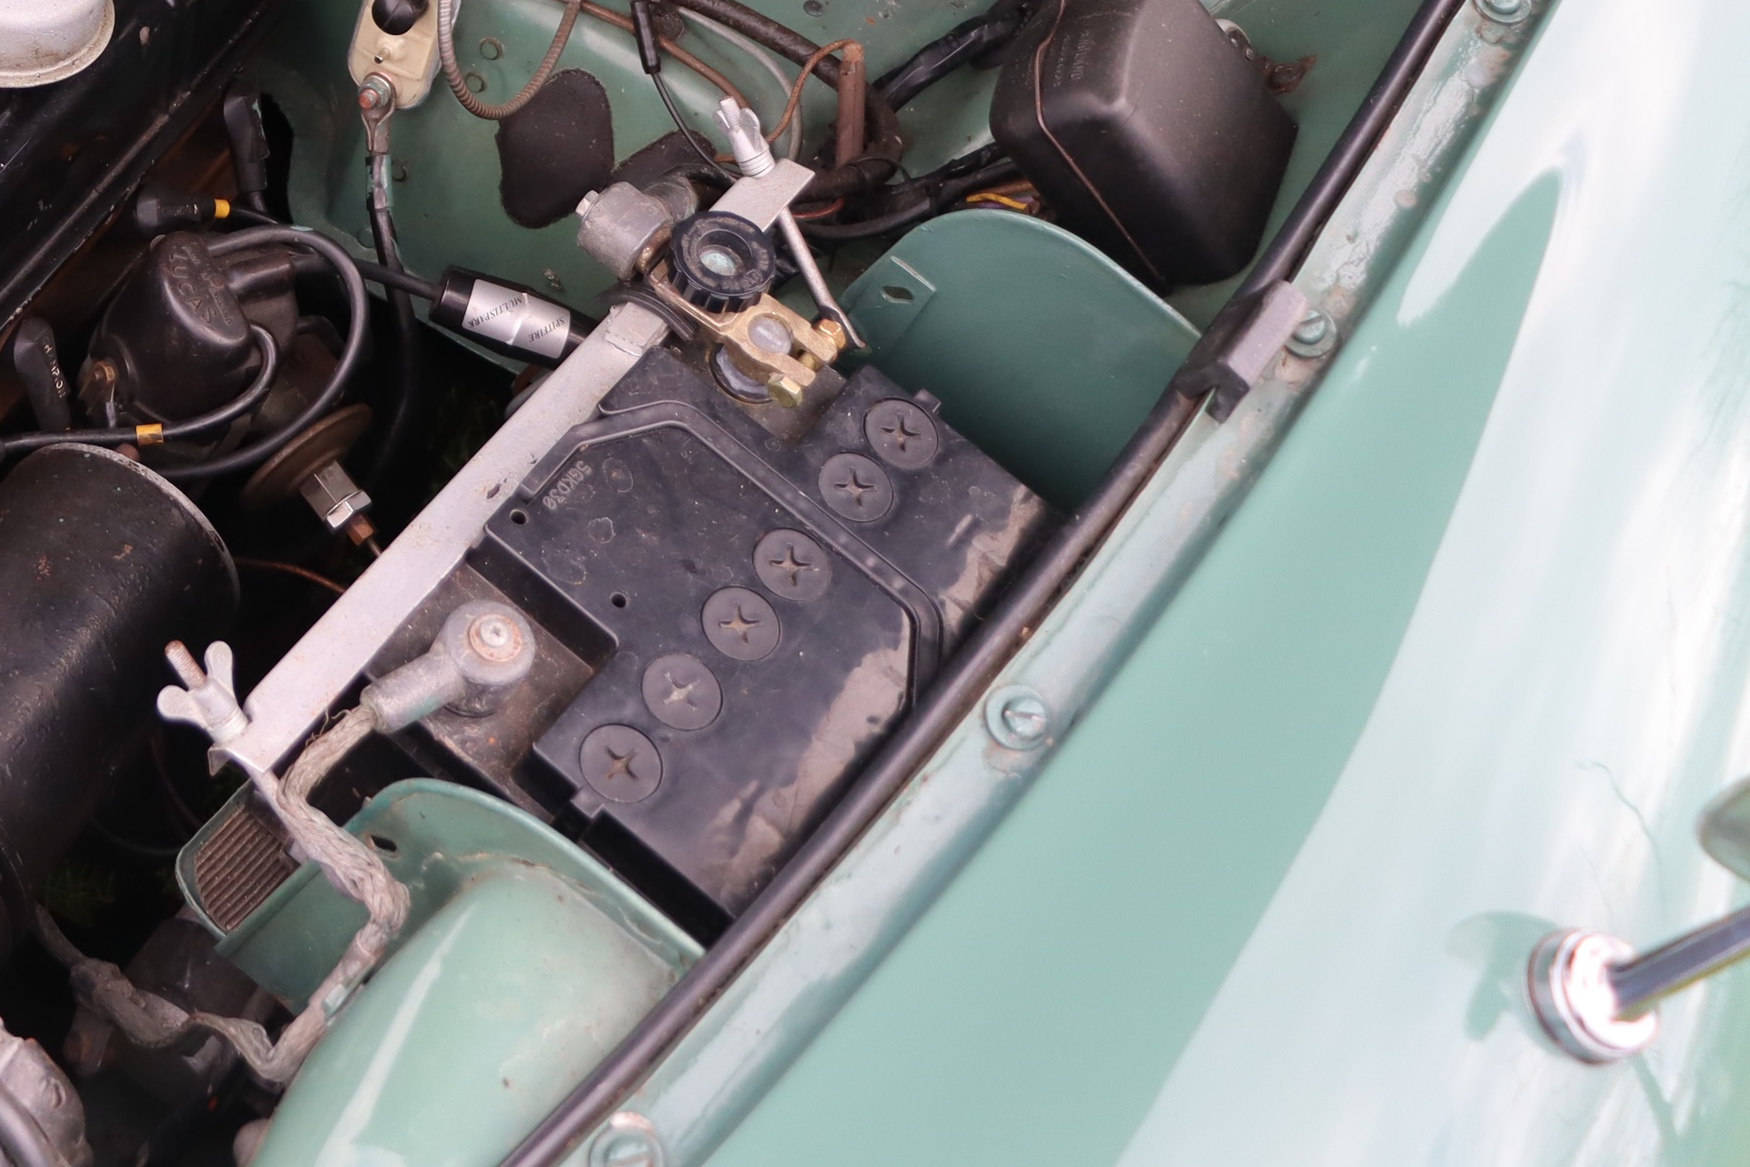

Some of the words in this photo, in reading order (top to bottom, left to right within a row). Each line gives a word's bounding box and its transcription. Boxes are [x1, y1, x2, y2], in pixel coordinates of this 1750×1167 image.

[169, 253, 218, 324] LUCAS
[467, 296, 523, 328] MULTISPARK
[528, 316, 566, 343] SPITFIRE
